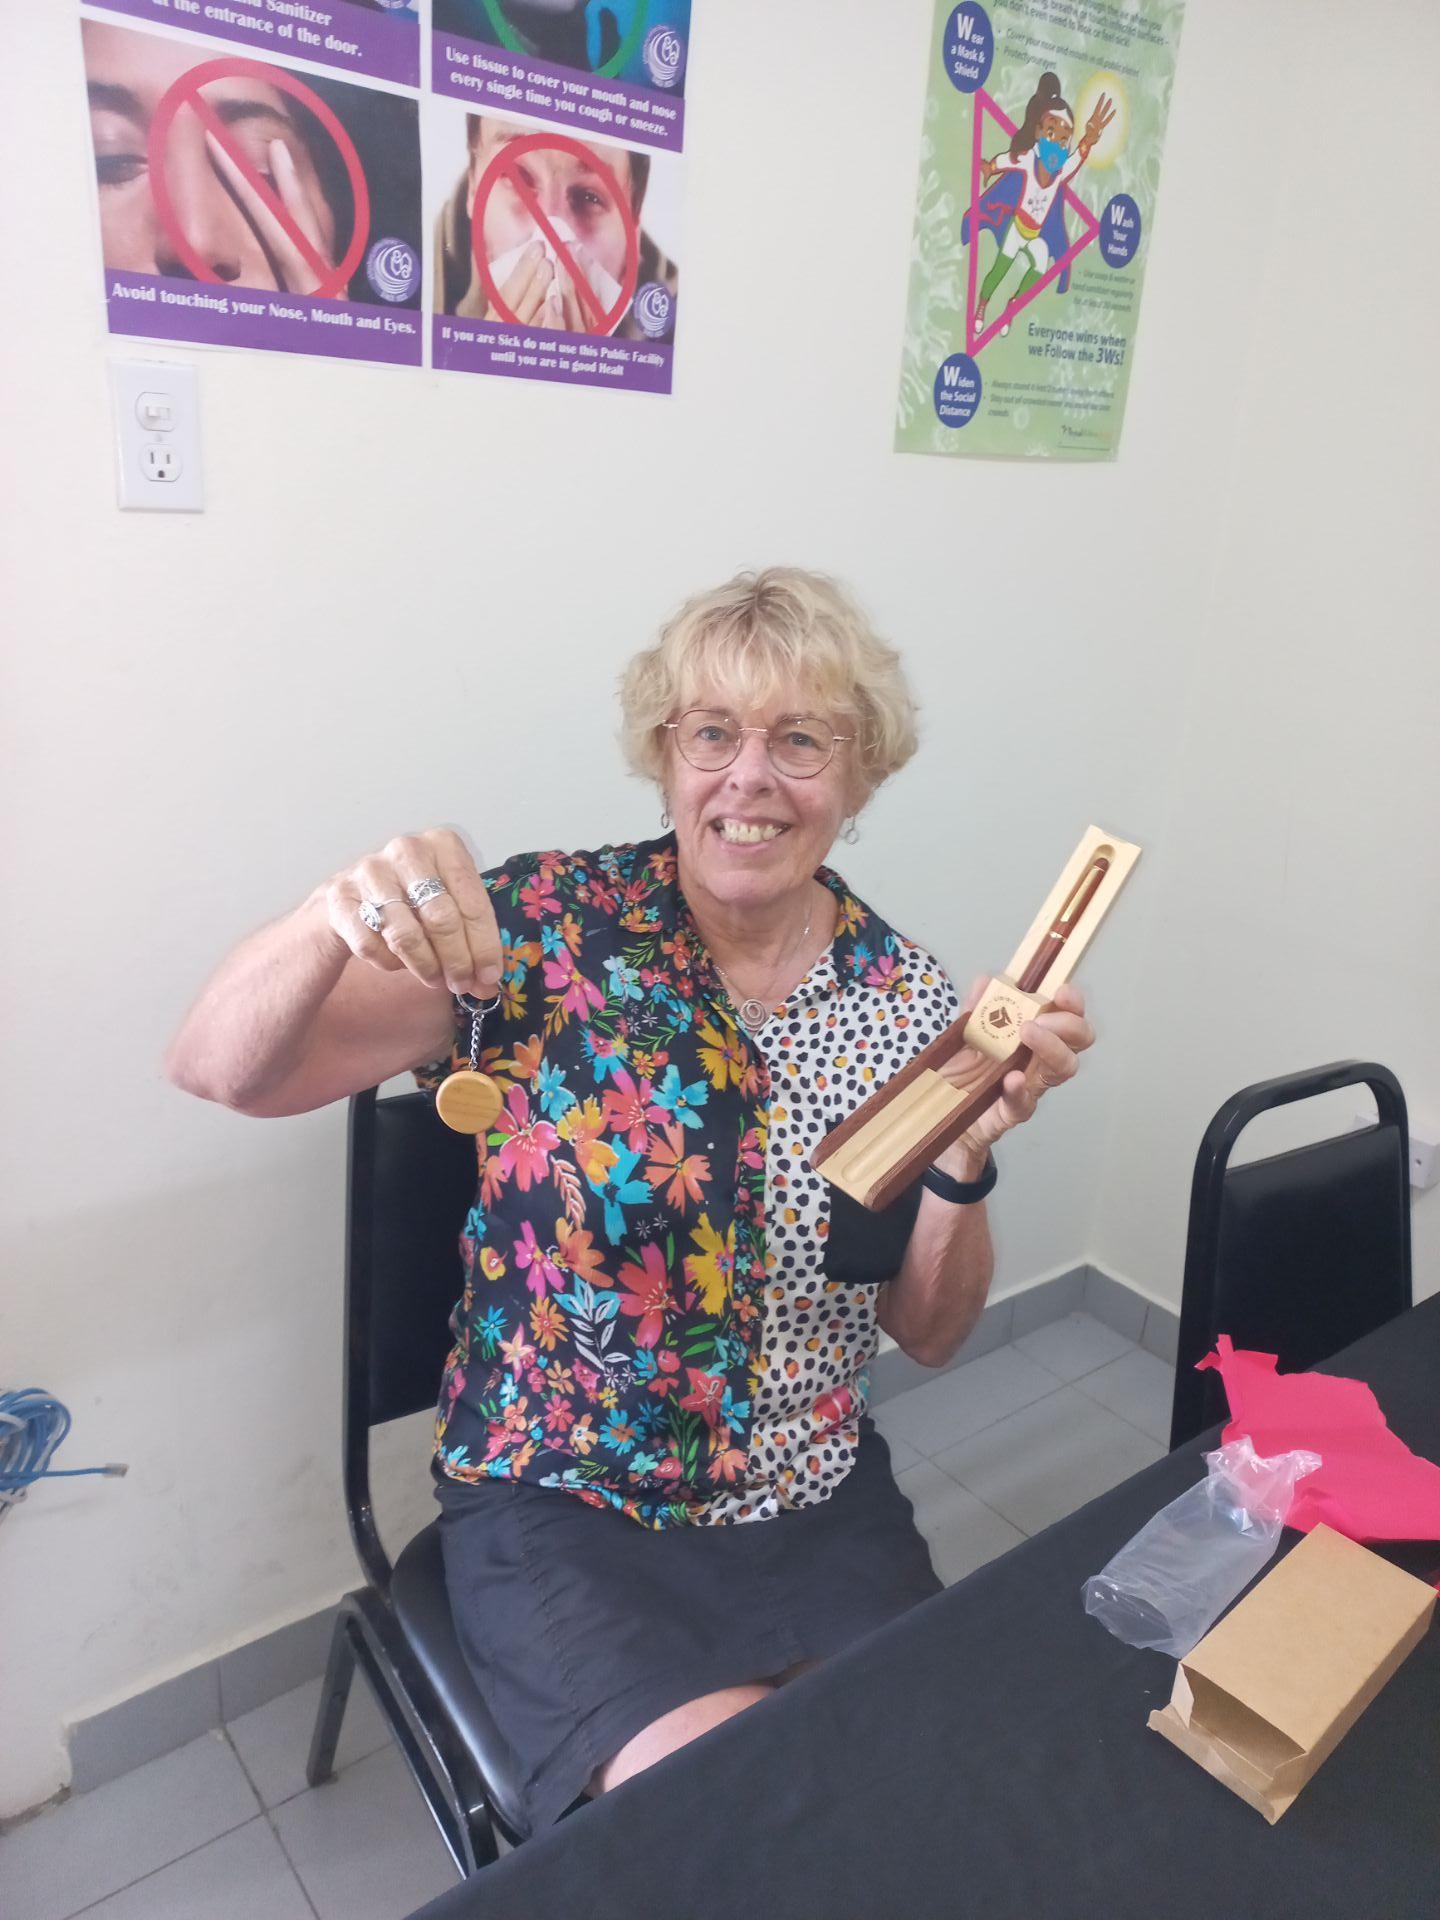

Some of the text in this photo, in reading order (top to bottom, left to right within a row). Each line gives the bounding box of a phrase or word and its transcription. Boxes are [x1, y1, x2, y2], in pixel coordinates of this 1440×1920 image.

[266, 0, 332, 26] Sanitizer
[174, 0, 200, 14] the
[204, 5, 274, 34] entrance
[278, 24, 293, 38] of
[296, 27, 320, 46] the
[325, 34, 362, 57] door.
[957, 12, 984, 44] Wear
[951, 44, 986, 64] a Mask &
[954, 61, 980, 79] Shield
[446, 46, 678, 120] Use tissue to cover your mouth and nose
[450, 72, 669, 136] every single time you cough or sneeze.
[1111, 204, 1134, 228] Wash
[1112, 230, 1128, 242] Your
[1108, 243, 1128, 256] Hands
[112, 282, 417, 334] Avoid touching your Nose, Mouth and Eyes.
[1028, 322, 1126, 348] Everyone wins when
[442, 326, 665, 368] If you are Sick do not use this Public Facility
[1028, 344, 1125, 366] we Follow the 3Ws!
[518, 354, 538, 366] you
[539, 357, 558, 368] are
[558, 358, 570, 370] in
[571, 360, 597, 374] good
[944, 365, 975, 388] Widen
[940, 390, 976, 402] the Social
[940, 404, 970, 416] Distance
